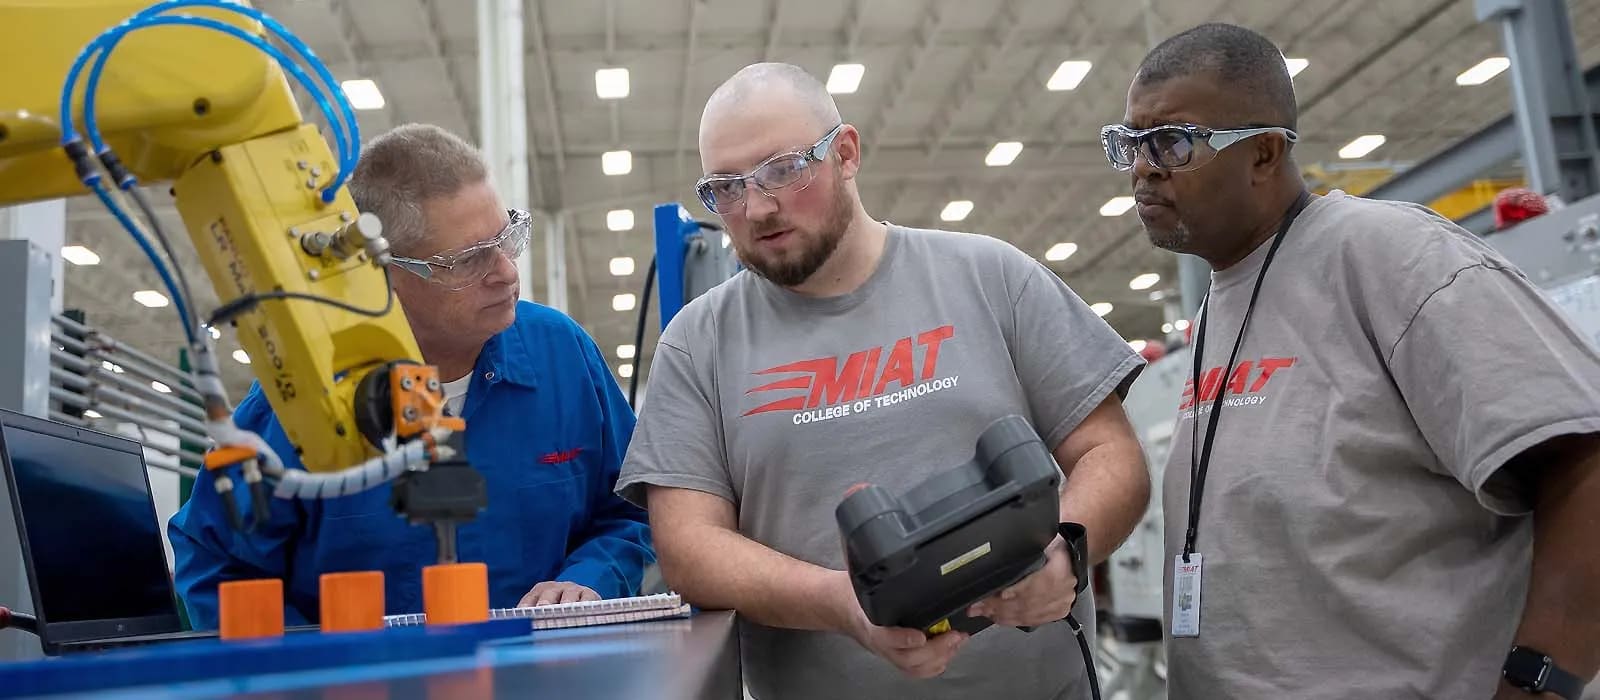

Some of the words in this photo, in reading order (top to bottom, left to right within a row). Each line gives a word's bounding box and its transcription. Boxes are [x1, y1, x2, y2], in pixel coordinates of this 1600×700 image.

[806, 325, 954, 408] MIAT
[793, 404, 850, 425] COLLEGE
[853, 399, 872, 413] OF
[875, 375, 959, 408] TECHNOLOGY
